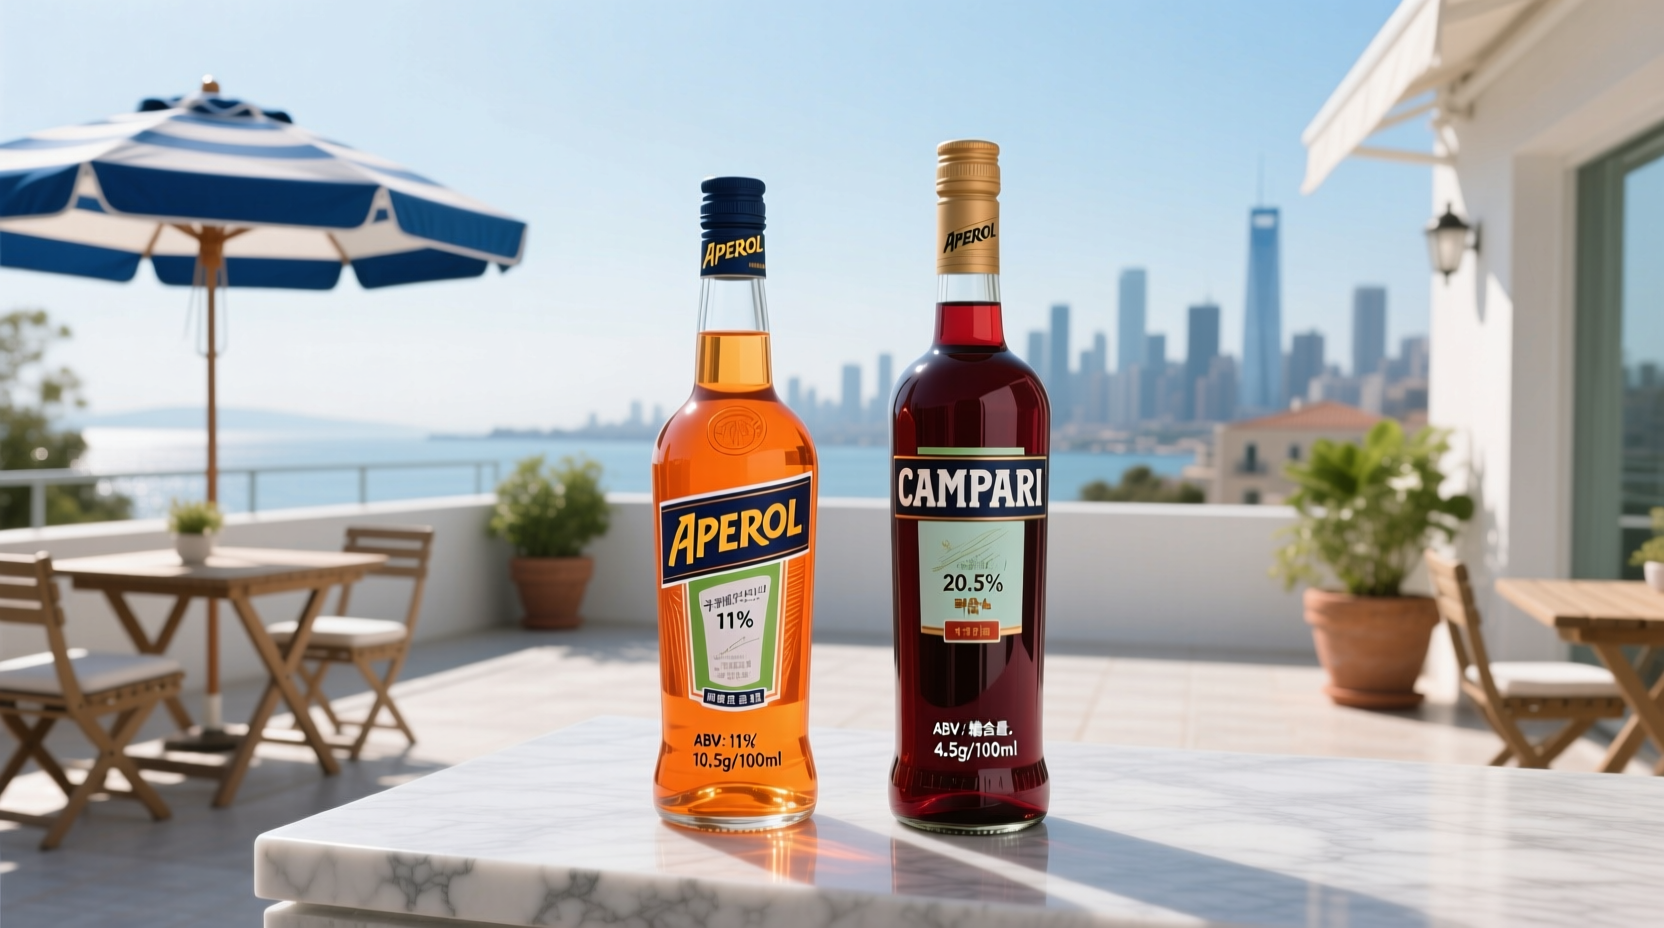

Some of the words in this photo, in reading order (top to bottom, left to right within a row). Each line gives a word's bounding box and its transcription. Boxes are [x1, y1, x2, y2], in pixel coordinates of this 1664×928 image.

[943, 222, 996, 254] APEROL
[702, 235, 764, 269] APEROL
[898, 467, 1042, 508] CAMPARI
[668, 498, 802, 567] APEROL
[943, 573, 1004, 592] 20.5%
[716, 610, 754, 629] 11%
[694, 733, 726, 747] ABV:
[730, 733, 757, 749] 11%
[934, 740, 1018, 762] 4.5g/100ml
[693, 751, 782, 772] 10.5g/100ml
